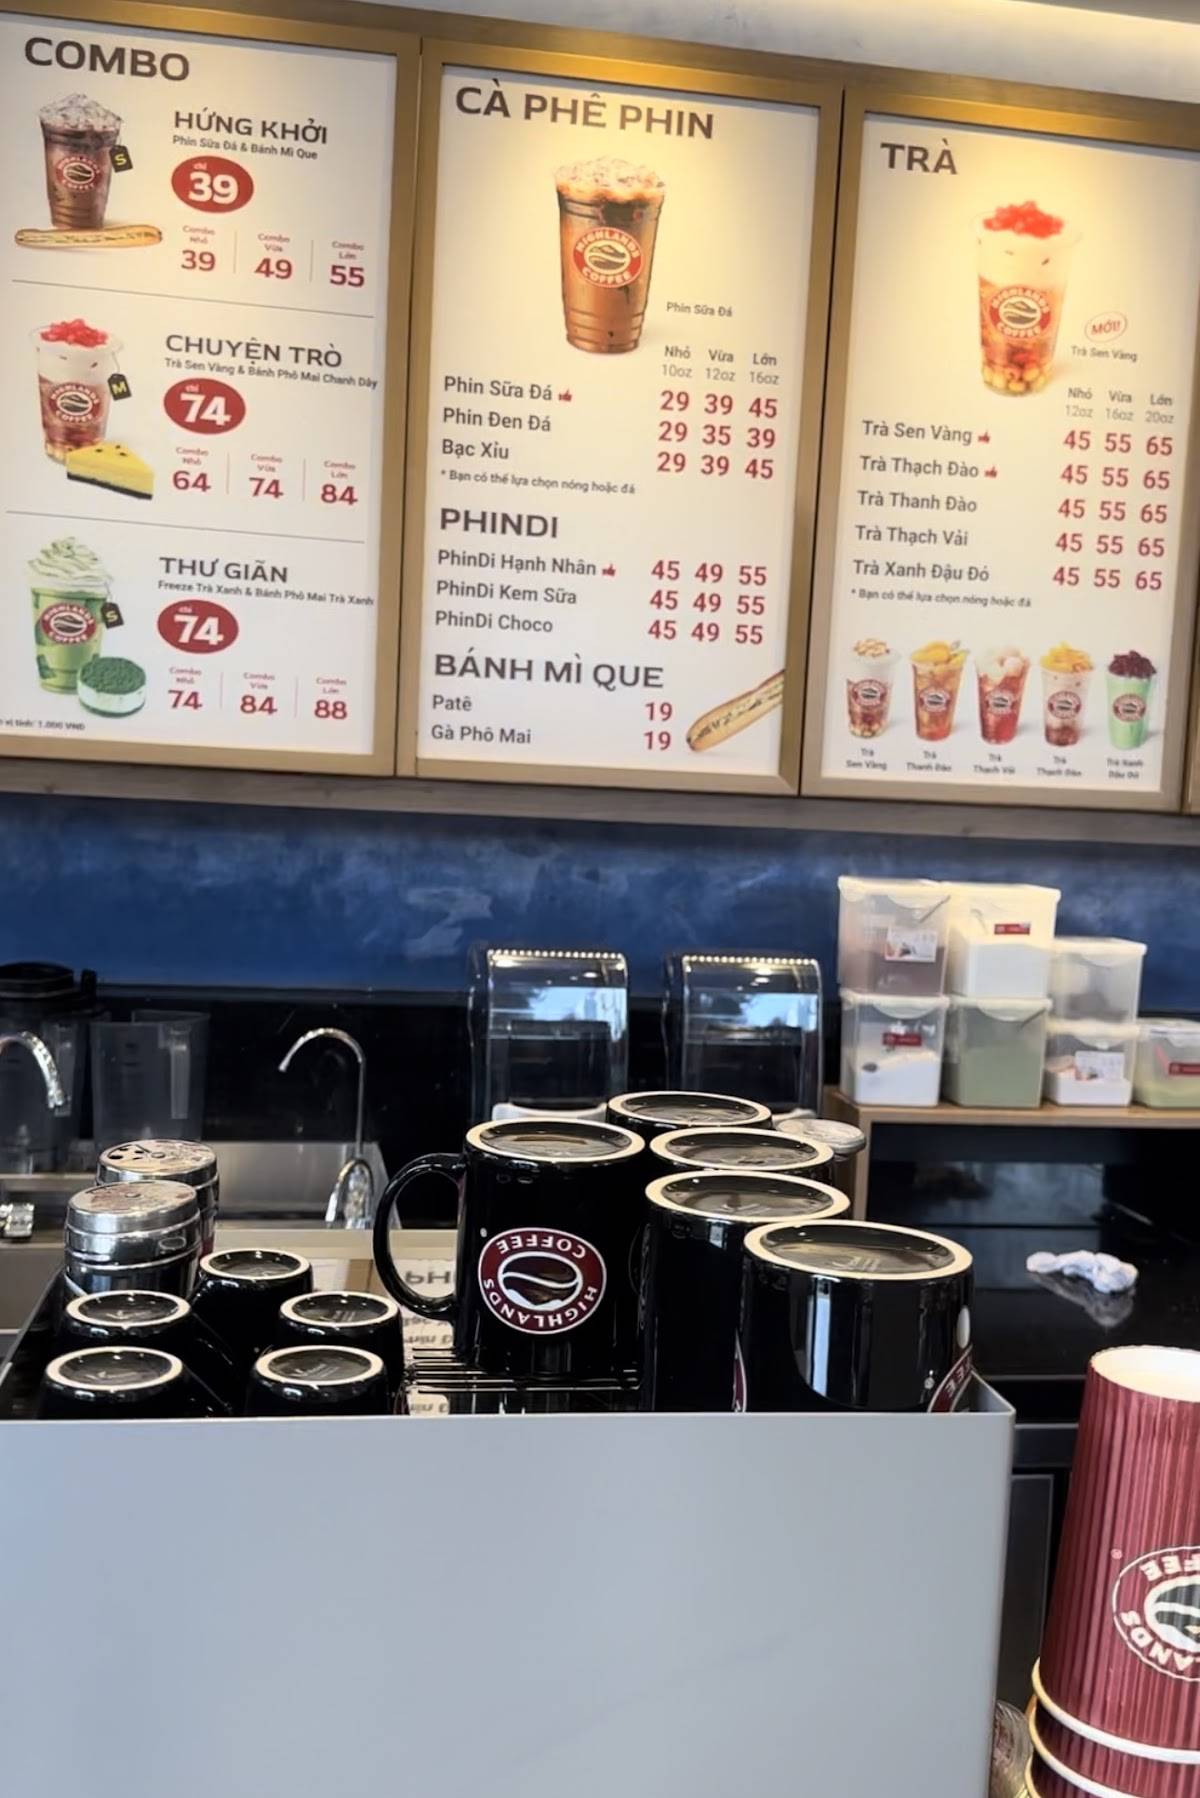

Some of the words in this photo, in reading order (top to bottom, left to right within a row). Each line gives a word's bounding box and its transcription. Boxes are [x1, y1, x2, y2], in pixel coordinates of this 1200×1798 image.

[25, 37, 190, 81] COMBO
[456, 79, 511, 117] CÀ
[524, 93, 607, 128] PHÊ
[619, 104, 715, 139] PHIN
[175, 107, 253, 136] HỨNG
[261, 118, 328, 144] KHỞI
[114, 153, 127, 166] S
[173, 135, 197, 146] Phin
[241, 143, 248, 152] &
[297, 150, 318, 160] Que
[880, 139, 958, 175] TRÀ
[188, 171, 239, 204] 39
[575, 228, 641, 258] HIGHLANDS
[181, 250, 216, 271] 39
[255, 258, 293, 279] 49
[330, 265, 365, 287] 55
[582, 266, 631, 285] COFFEE
[666, 302, 691, 314] Phin
[694, 304, 715, 317] Sữa
[717, 306, 733, 317] Đá
[166, 335, 280, 365] CHUYỆN
[289, 343, 342, 367] TRÒ
[708, 349, 734, 363] Vừa
[753, 353, 777, 367] Lớn
[185, 360, 206, 370] Sen
[238, 366, 245, 375] &
[301, 371, 320, 382] Mai
[323, 373, 356, 385] Chanh
[662, 364, 692, 379] 10oz
[705, 368, 735, 382] 12oz
[749, 371, 780, 386] 16oz
[112, 381, 127, 394] M
[444, 376, 484, 395] Phin
[489, 379, 523, 399] Sữa
[529, 383, 552, 401] Đá
[180, 392, 232, 426] 74
[661, 390, 690, 411] 29
[704, 394, 734, 415] 39
[748, 398, 778, 419] 45
[1066, 405, 1093, 418] 12oz
[1106, 408, 1134, 421] 16oz
[1145, 411, 1174, 423] 20oz
[442, 408, 483, 427] Phin
[488, 412, 523, 430] Đen
[528, 415, 552, 432] Đá
[658, 421, 688, 442] 29
[702, 425, 732, 446] 35
[746, 428, 776, 449] 39
[862, 420, 889, 437] Trà
[894, 422, 926, 439] Sen
[931, 426, 972, 446] Vàng
[1064, 430, 1091, 450] 45
[1104, 433, 1132, 452] 55
[1146, 436, 1173, 456] 65
[442, 438, 475, 459] Bạc
[657, 452, 686, 473] 29
[700, 455, 730, 476] 39
[745, 458, 774, 480] 45
[860, 456, 887, 472] Trà
[892, 458, 942, 476] Thạch
[948, 461, 979, 478] Đào
[1061, 464, 1088, 484] 45
[1102, 468, 1129, 487] 55
[1143, 471, 1170, 490] 65
[173, 471, 211, 492] 64
[249, 477, 284, 498] 74
[321, 484, 358, 505] 84
[858, 491, 884, 507] Trà
[889, 492, 941, 510] Thanh
[946, 495, 977, 512] Đào
[1058, 499, 1086, 519] 45
[1099, 501, 1126, 521] 55
[1141, 504, 1168, 524] 65
[440, 507, 559, 539] PHINDI
[855, 525, 882, 541] Trà
[887, 527, 938, 546] Thạch
[1056, 532, 1082, 552] 45
[1096, 536, 1123, 554] 55
[1138, 538, 1165, 558] 65
[159, 557, 220, 577] THƯ
[225, 560, 288, 583] GIÃN
[438, 550, 496, 570] PhinDi
[501, 554, 546, 574] Hạnh
[551, 558, 597, 575] Nhân
[651, 560, 680, 581] 45
[694, 563, 724, 583] 49
[738, 566, 767, 586] 55
[853, 559, 879, 576] Trà
[885, 561, 926, 578] Xanh
[931, 563, 963, 582] Đậu
[1053, 566, 1080, 586] 45
[1094, 569, 1121, 588] 55
[1135, 571, 1162, 591] 65
[158, 580, 194, 592] Freeze
[216, 585, 242, 595] Xanh
[246, 587, 252, 596] &
[307, 593, 326, 602] Mai
[348, 595, 374, 606] Xanh
[436, 580, 495, 599] PhinDi
[499, 584, 538, 602] Kem
[543, 587, 577, 604] Sữa
[650, 590, 678, 611] 45
[693, 593, 722, 613] 49
[736, 595, 765, 616] 55
[105, 610, 118, 622] S
[435, 610, 493, 629] PhinDi
[498, 614, 553, 633] Choco
[174, 614, 224, 646] 74
[648, 620, 676, 640] 45
[691, 623, 720, 642] 49
[735, 625, 763, 645] 55
[434, 647, 533, 681] BÁNH
[545, 654, 583, 684] MÌ
[592, 662, 665, 692] QUE
[168, 689, 202, 710] 74
[240, 695, 278, 715] 84
[314, 700, 347, 719] 88
[432, 694, 472, 712] Patê
[645, 702, 672, 722] 19
[431, 724, 454, 741] Gà
[459, 726, 494, 743] Phô
[499, 729, 531, 744] Mai
[644, 732, 671, 751] 19
[496, 1234, 586, 1259] COFFEE
[483, 1279, 598, 1328] HIGHLANDS
